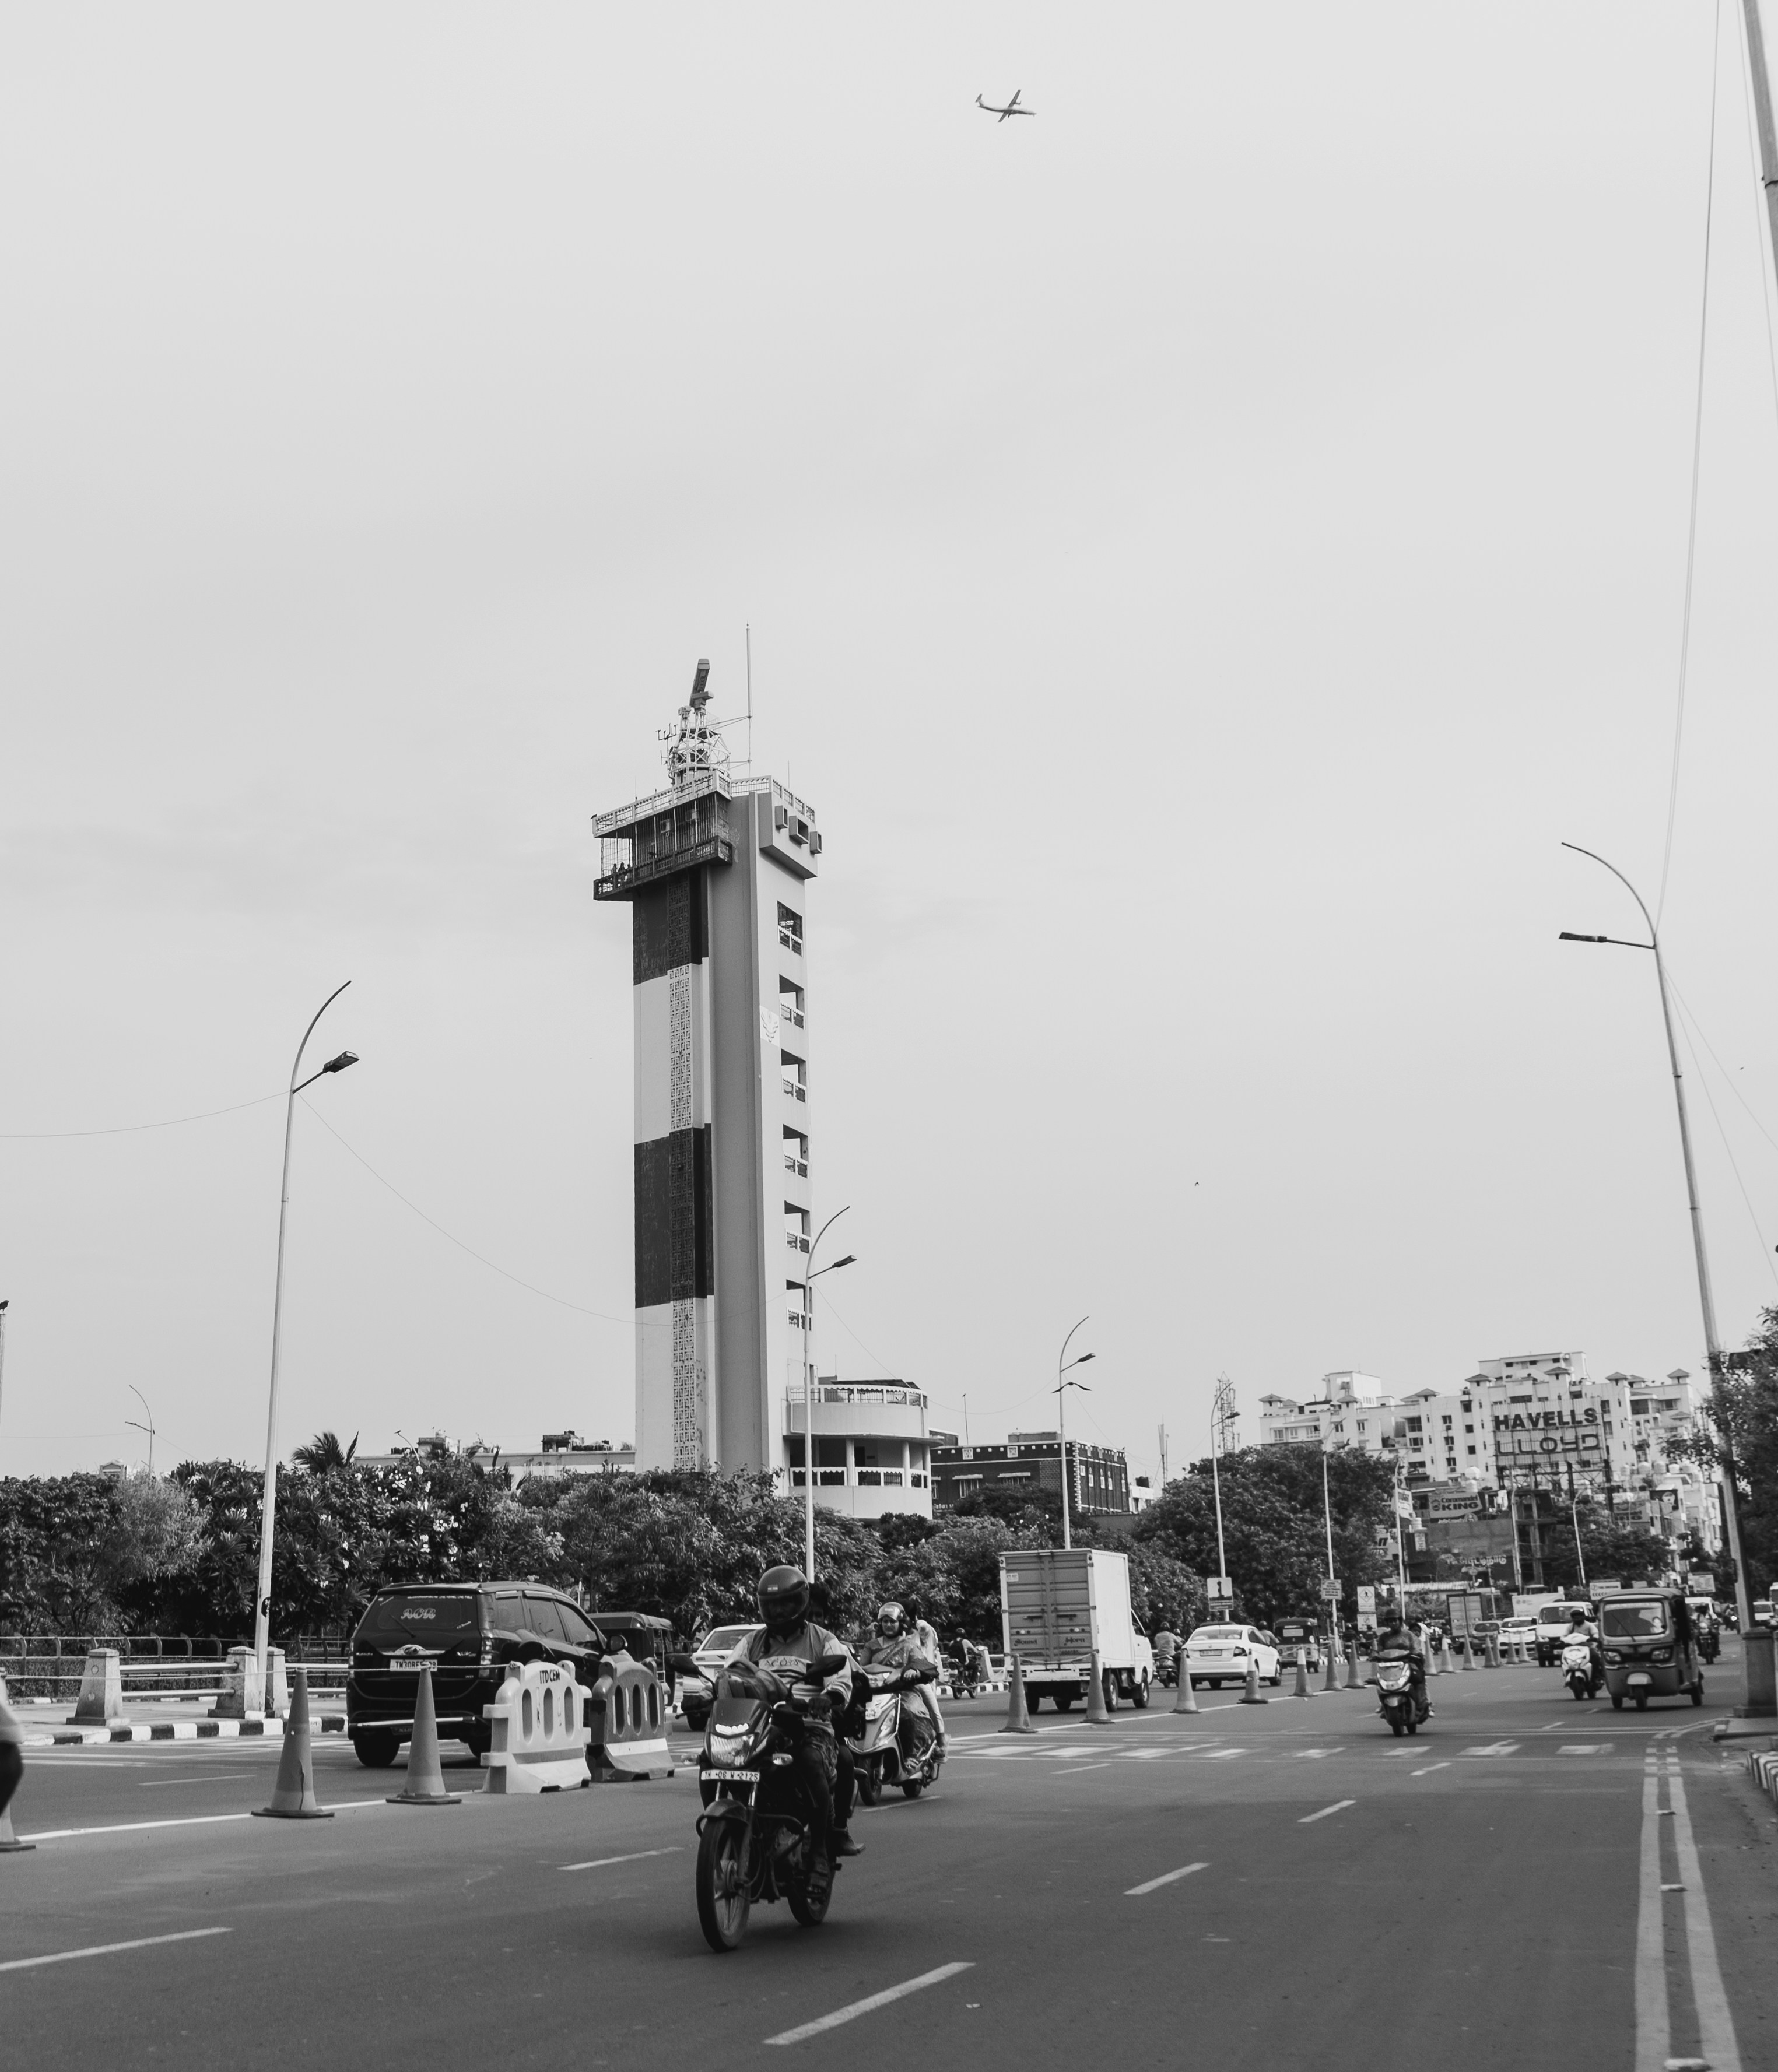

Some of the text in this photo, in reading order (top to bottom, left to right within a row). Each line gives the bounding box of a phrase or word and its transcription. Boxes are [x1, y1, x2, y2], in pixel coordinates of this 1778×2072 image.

[1495, 1407, 1598, 1430] HAVELLS
[1497, 1434, 1600, 1455] LLOYD
[1442, 1502, 1479, 1511] KING
[1014, 1638, 1037, 1646] Sound
[1064, 1637, 1085, 1646] Horn
[539, 1669, 560, 1684] ITD CEM
[704, 1771, 711, 1779] TN
